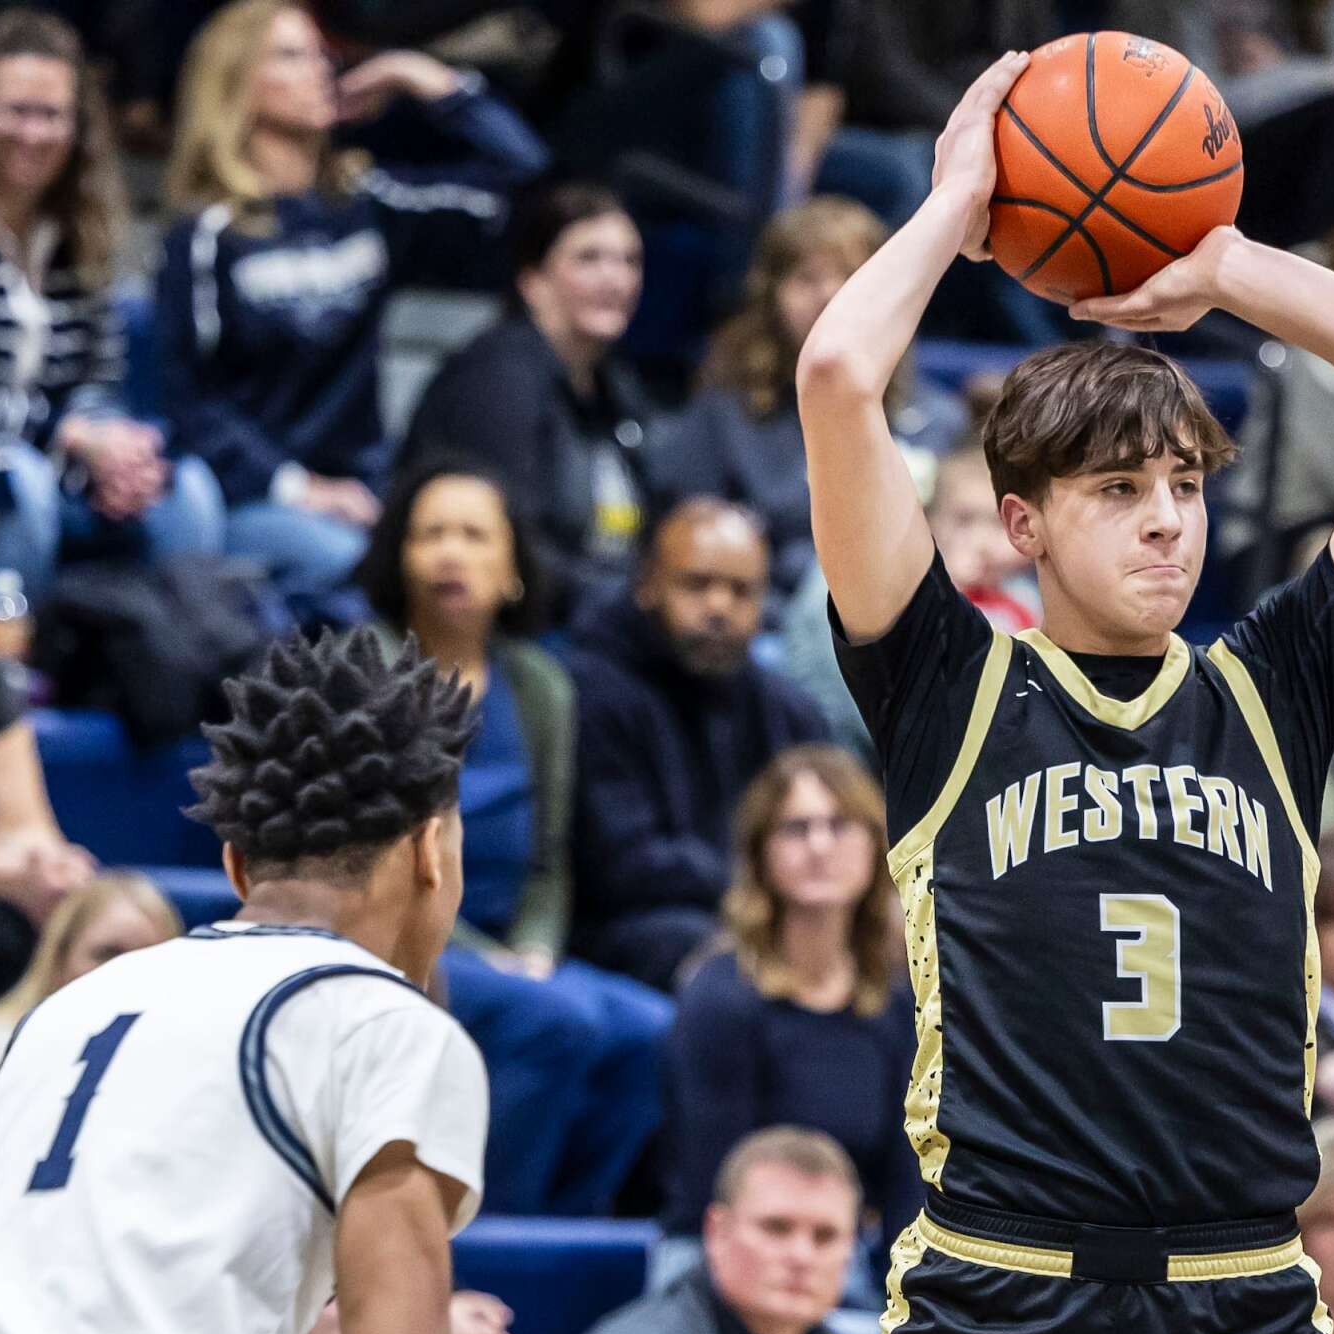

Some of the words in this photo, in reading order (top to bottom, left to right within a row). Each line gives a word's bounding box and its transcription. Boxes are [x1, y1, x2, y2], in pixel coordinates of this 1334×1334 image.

[986, 761, 1272, 892] WESTERN
[1099, 893, 1181, 1041] 3
[28, 1012, 142, 1192] 1
